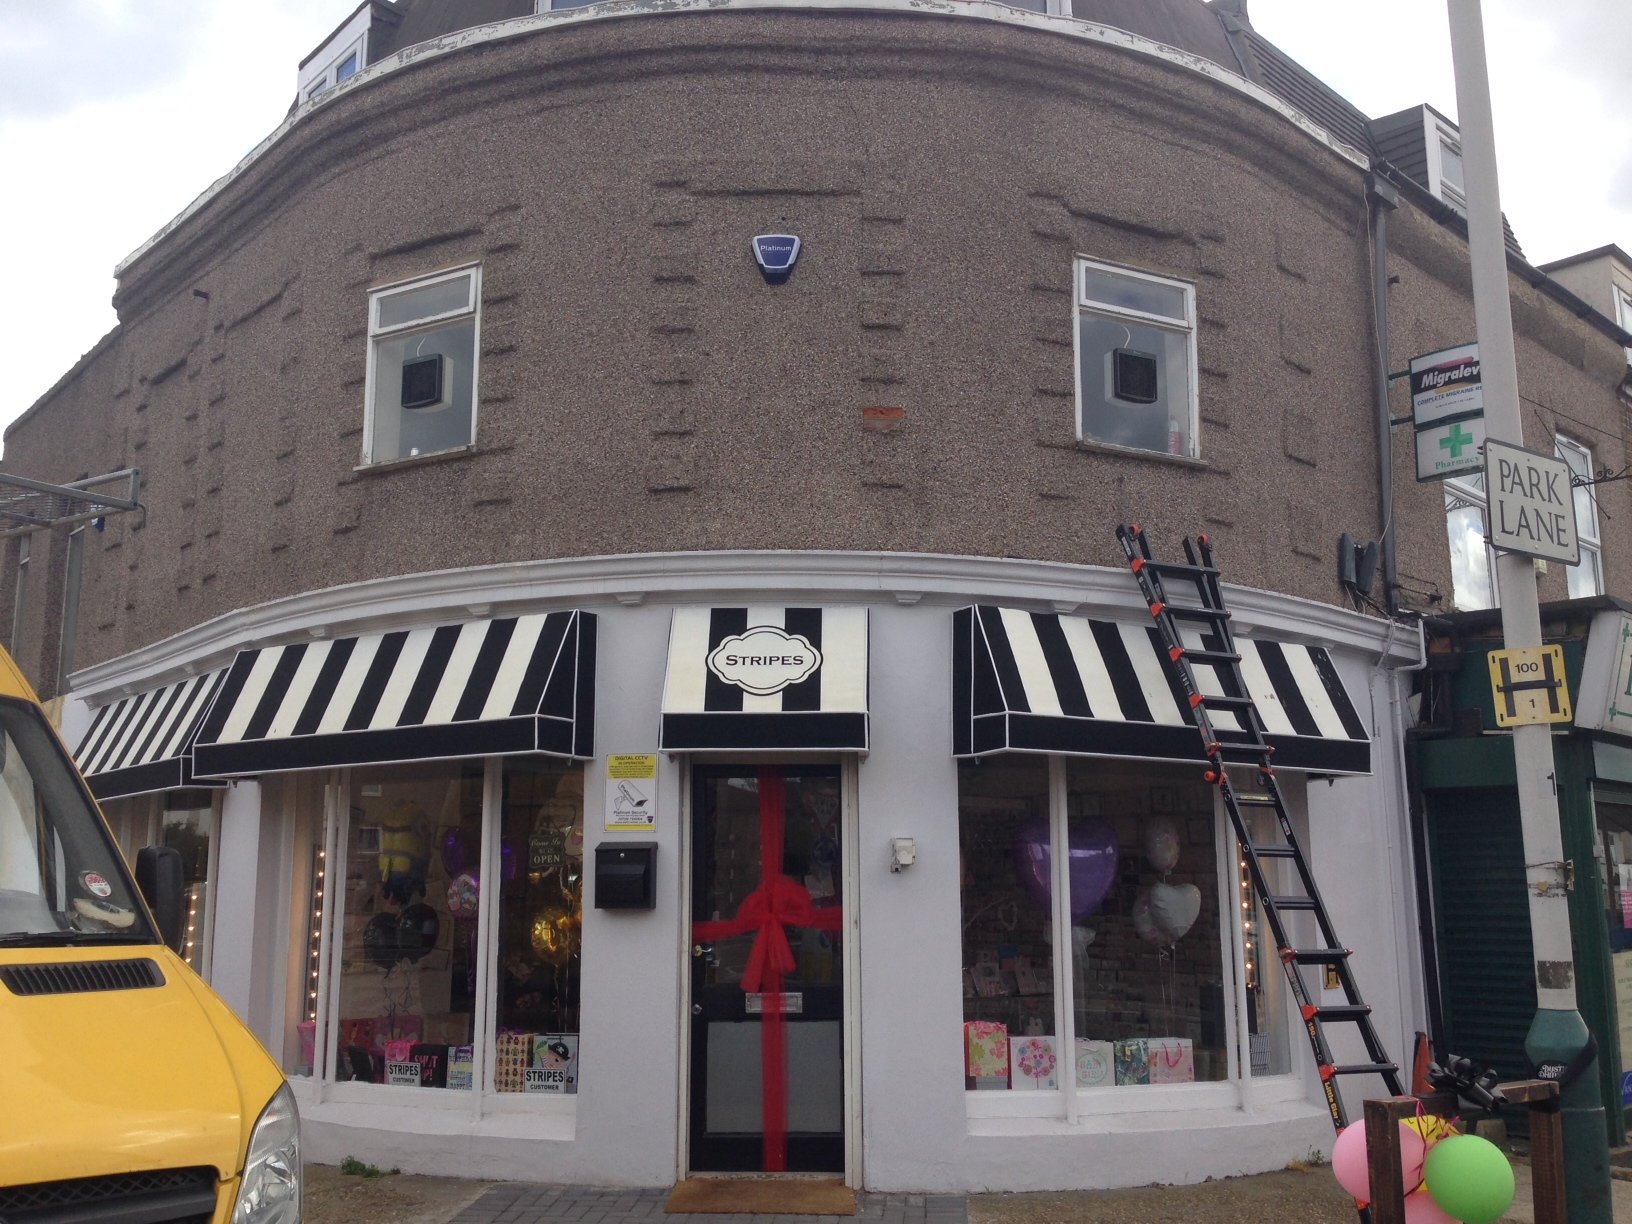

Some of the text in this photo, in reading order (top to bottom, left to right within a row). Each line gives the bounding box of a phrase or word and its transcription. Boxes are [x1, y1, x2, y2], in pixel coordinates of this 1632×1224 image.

[1421, 364, 1481, 389] Migralev
[1417, 393, 1444, 407] COMPLETE
[1435, 456, 1480, 470] Pharmacy
[1498, 458, 1563, 506] PARK
[1499, 500, 1569, 548] LANE
[725, 654, 804, 666] STRIPES
[1514, 662, 1539, 674] 100
[1529, 698, 1536, 709] 1
[533, 854, 560, 864] OPEN
[389, 1064, 419, 1077] STRIPES
[526, 1070, 564, 1083] STRIPES
